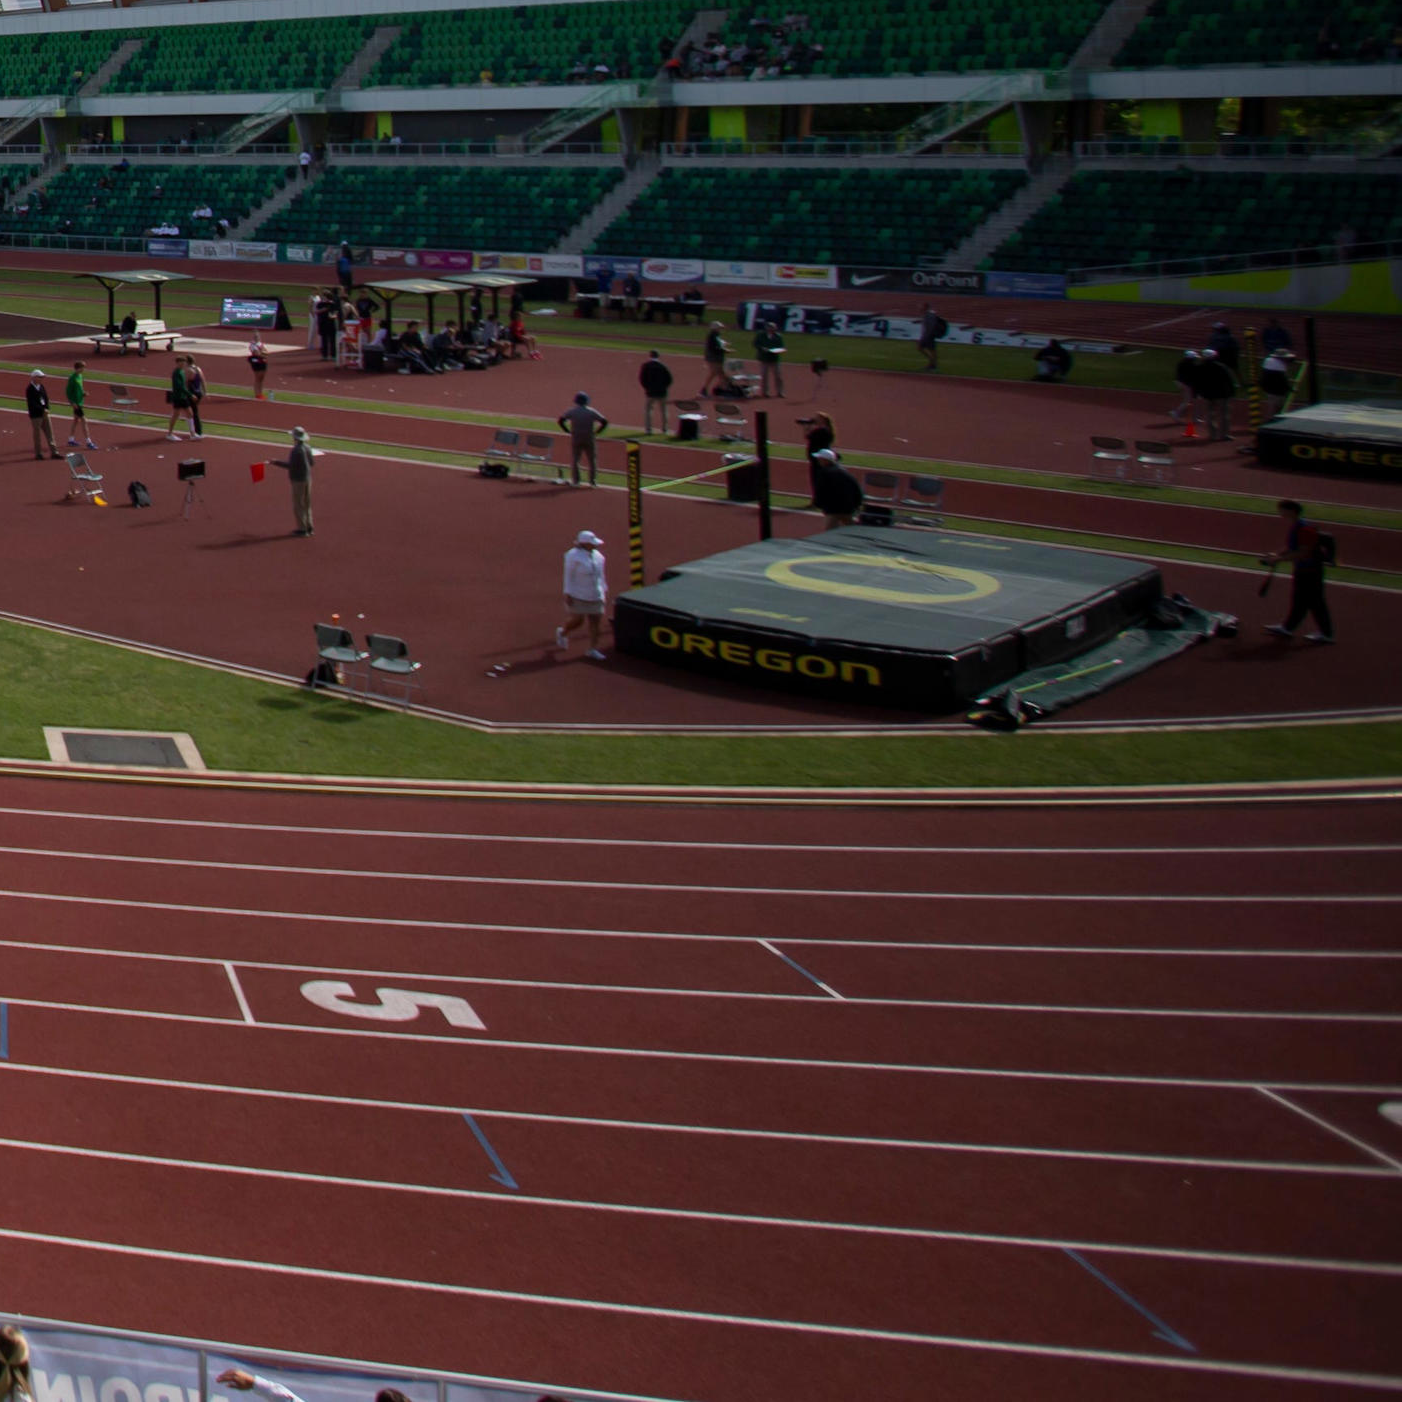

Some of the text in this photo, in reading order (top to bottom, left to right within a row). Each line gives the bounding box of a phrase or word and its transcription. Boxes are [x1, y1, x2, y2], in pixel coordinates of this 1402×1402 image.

[912, 271, 980, 289] OnPoint
[742, 301, 758, 332] 1
[783, 308, 806, 333] 2
[829, 314, 852, 336] 3
[873, 319, 890, 337] 4
[649, 624, 883, 687] OREGON
[299, 979, 488, 1031] 5
